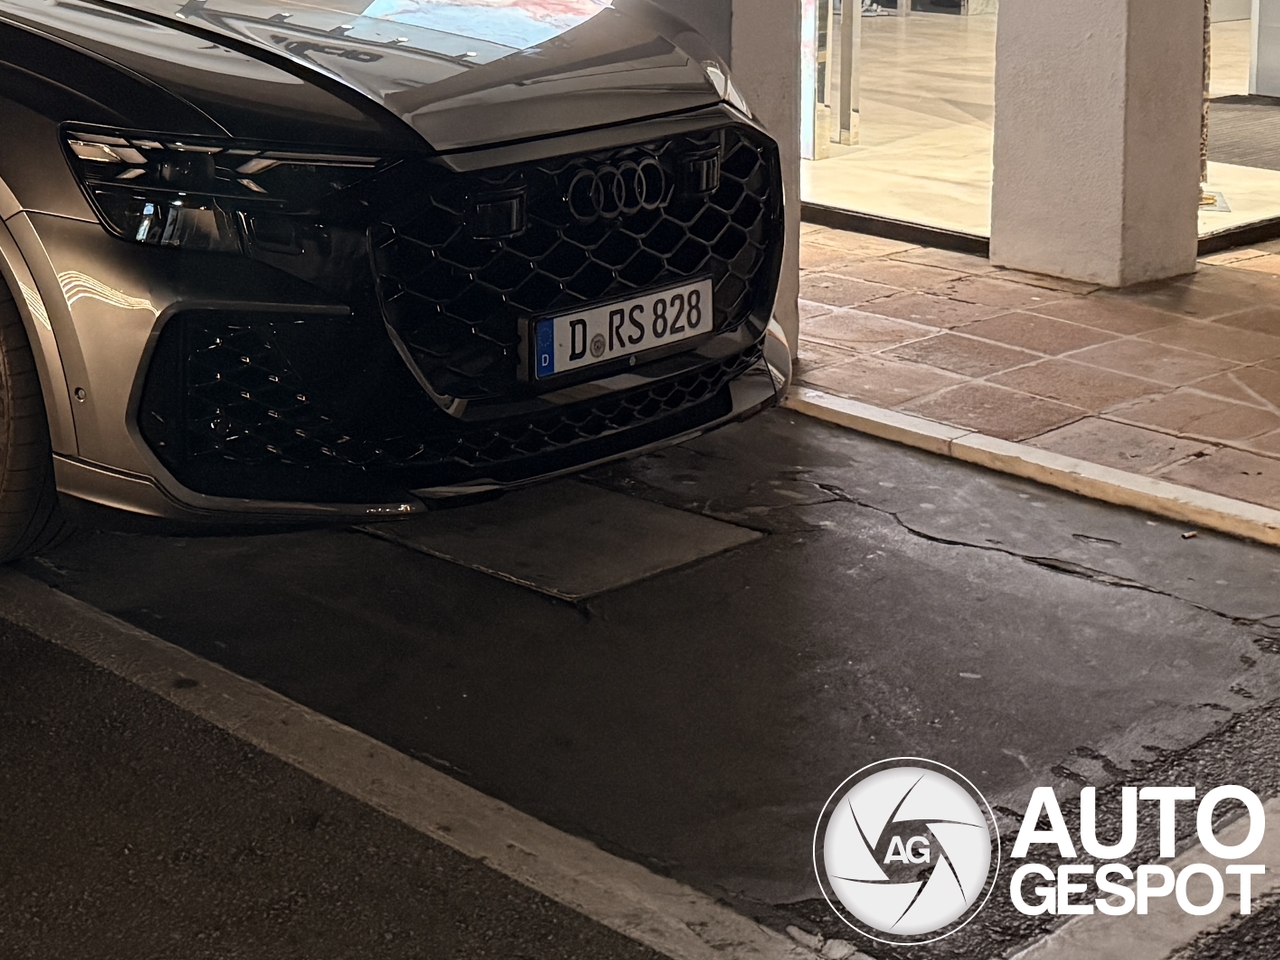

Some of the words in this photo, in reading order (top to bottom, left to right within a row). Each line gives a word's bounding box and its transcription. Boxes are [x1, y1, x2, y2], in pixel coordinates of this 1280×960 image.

[569, 318, 587, 361] D
[609, 304, 645, 351] RS
[652, 290, 701, 338] 828
[542, 354, 550, 367] D
